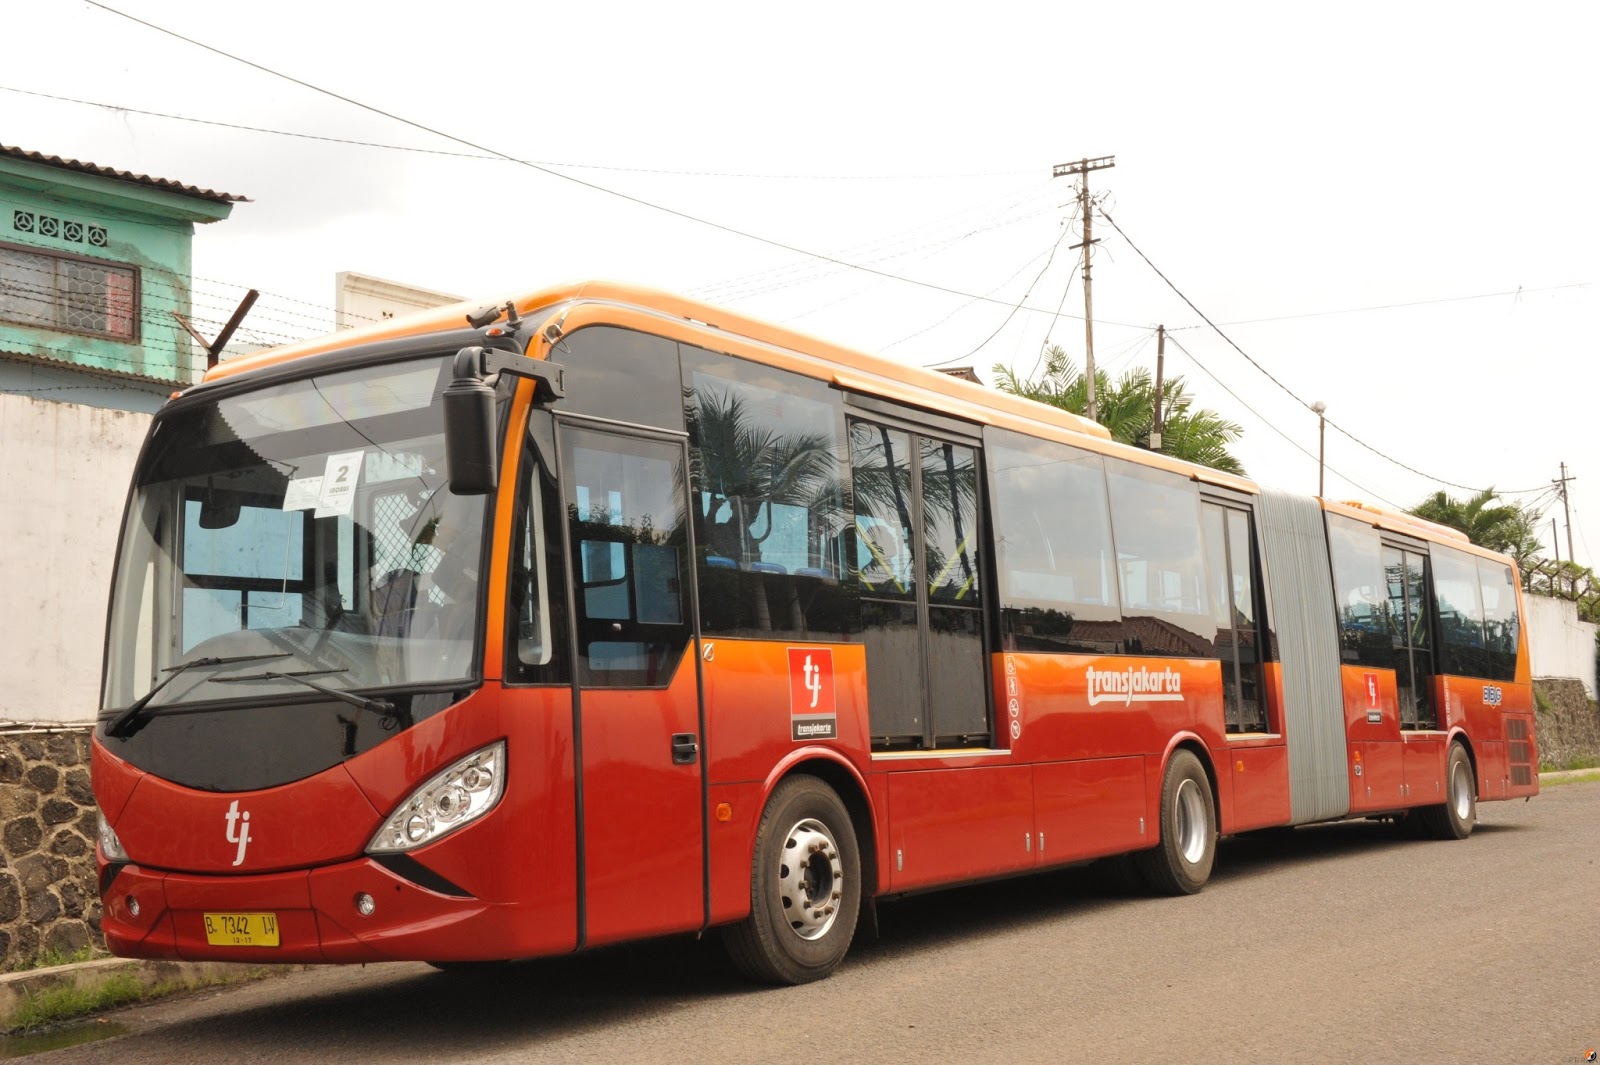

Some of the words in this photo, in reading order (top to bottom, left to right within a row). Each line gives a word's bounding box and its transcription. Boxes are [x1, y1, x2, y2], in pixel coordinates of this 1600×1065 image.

[335, 465, 349, 483] 2
[803, 654, 822, 708] tj
[1086, 666, 1184, 707] transjakarta
[1482, 686, 1502, 703] BBG
[225, 800, 252, 866] tj
[205, 916, 214, 934] B
[221, 916, 250, 935] 7342
